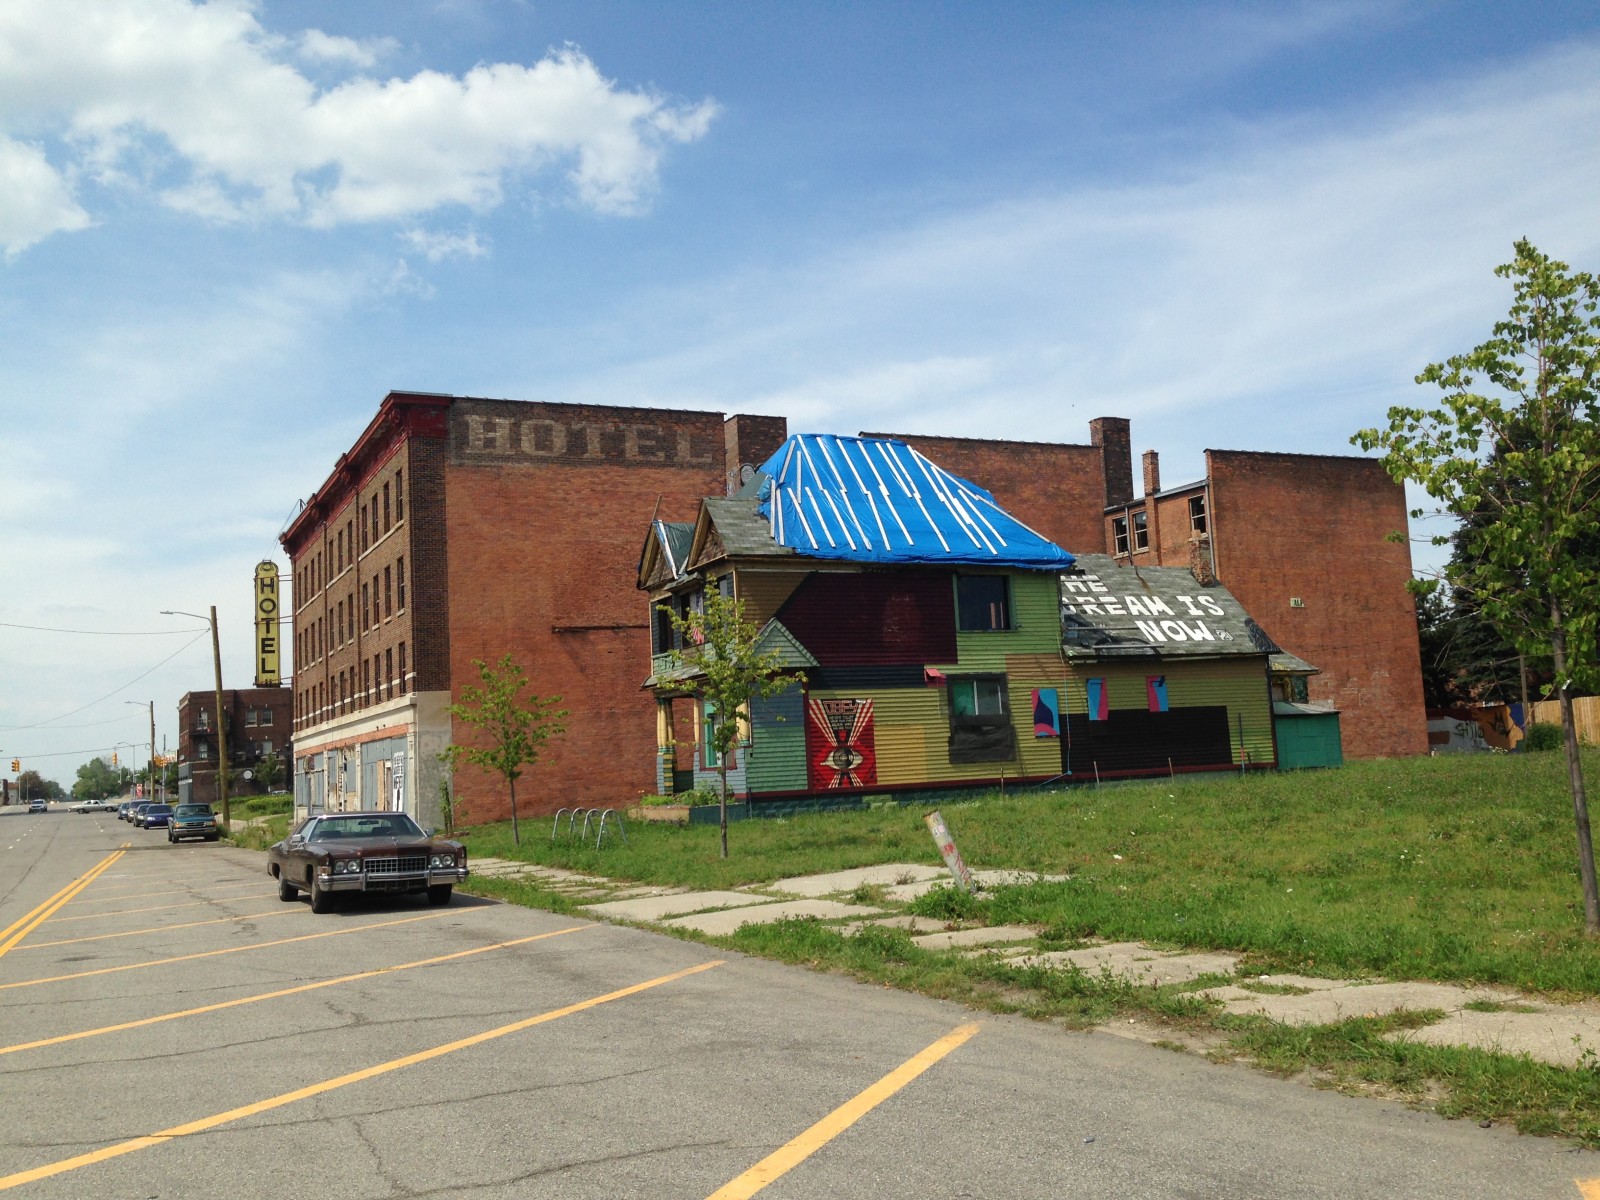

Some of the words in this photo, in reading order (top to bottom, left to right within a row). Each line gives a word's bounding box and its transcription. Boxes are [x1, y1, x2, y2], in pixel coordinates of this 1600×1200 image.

[463, 413, 713, 463] HOTEL
[1060, 575, 1109, 592] HE
[1177, 595, 1225, 616] IS
[260, 577, 277, 674] HOTEL
[1134, 620, 1216, 643] NOW
[823, 700, 859, 715] OBEY
